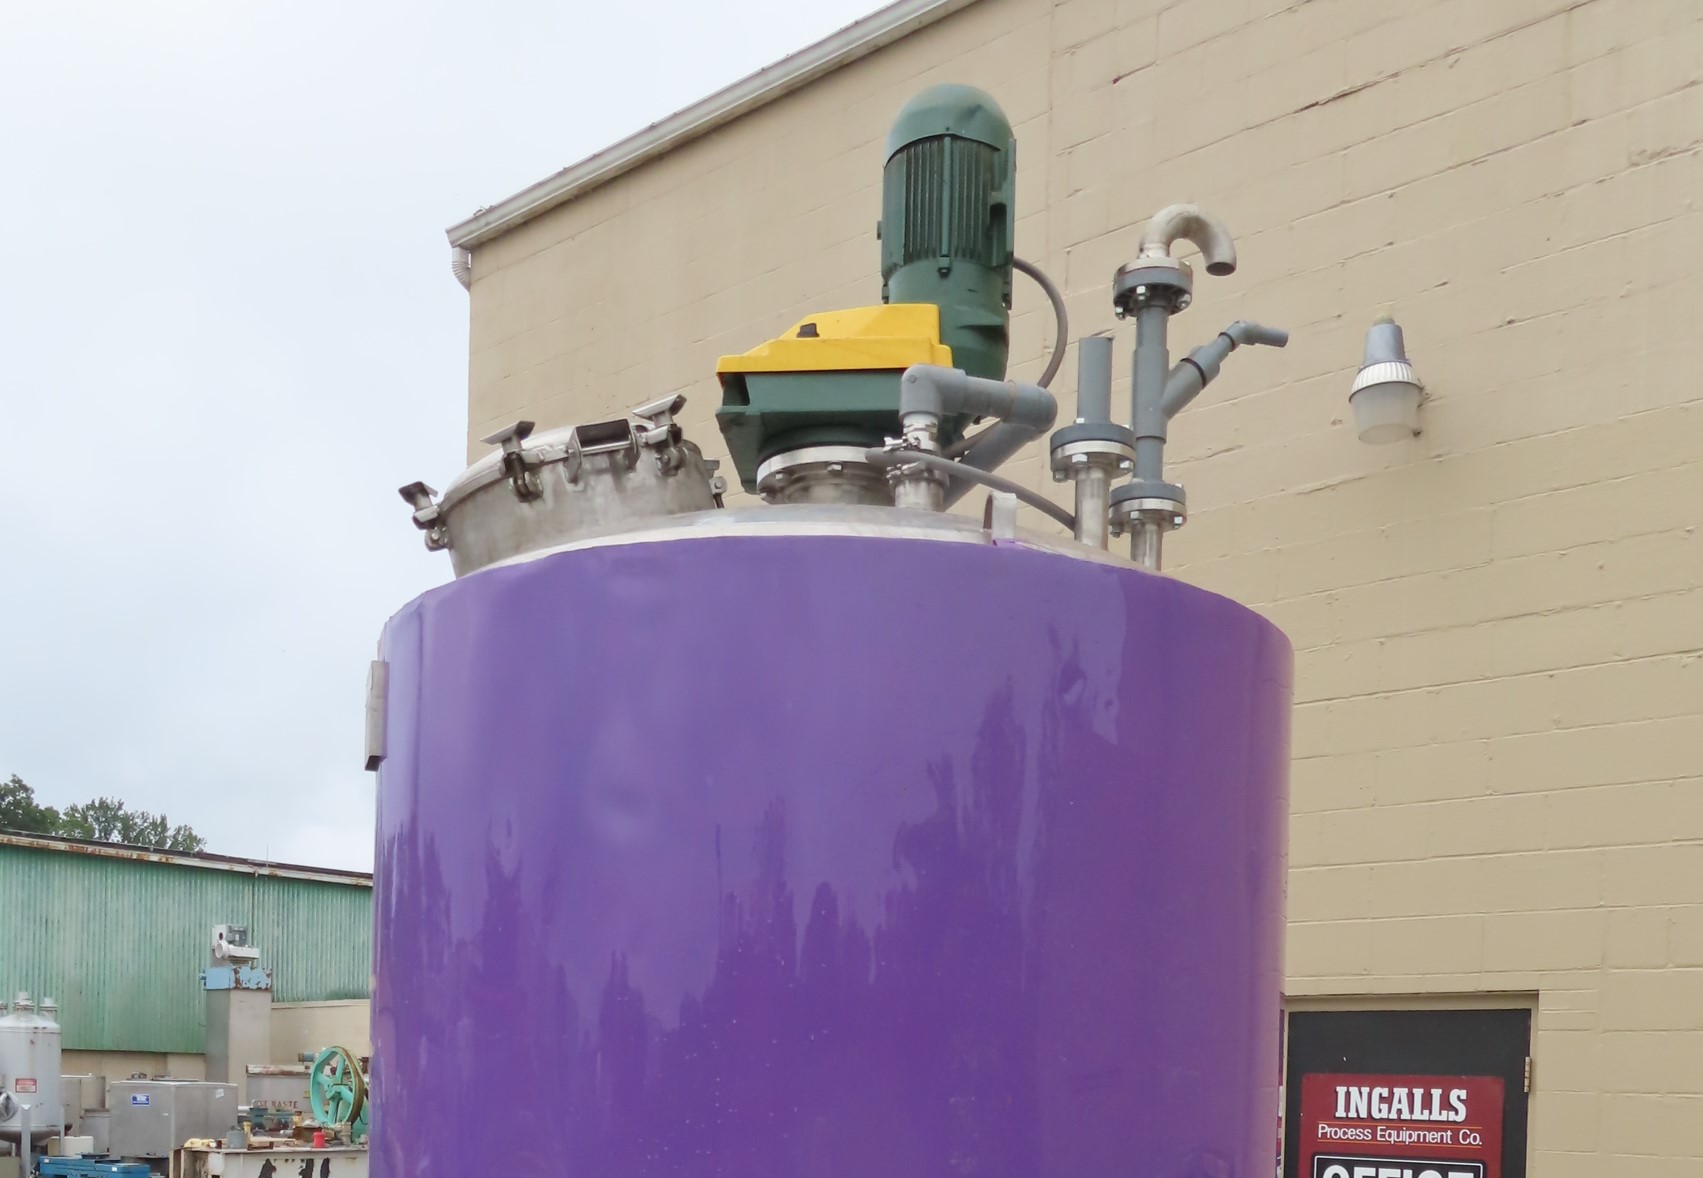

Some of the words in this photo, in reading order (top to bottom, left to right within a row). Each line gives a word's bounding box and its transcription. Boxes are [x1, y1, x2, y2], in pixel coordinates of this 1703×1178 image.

[1335, 1086, 1467, 1122] INGALLS
[1318, 1124, 1372, 1140] Process
[1377, 1126, 1453, 1144] Equipment
[1459, 1129, 1483, 1145] Co.
